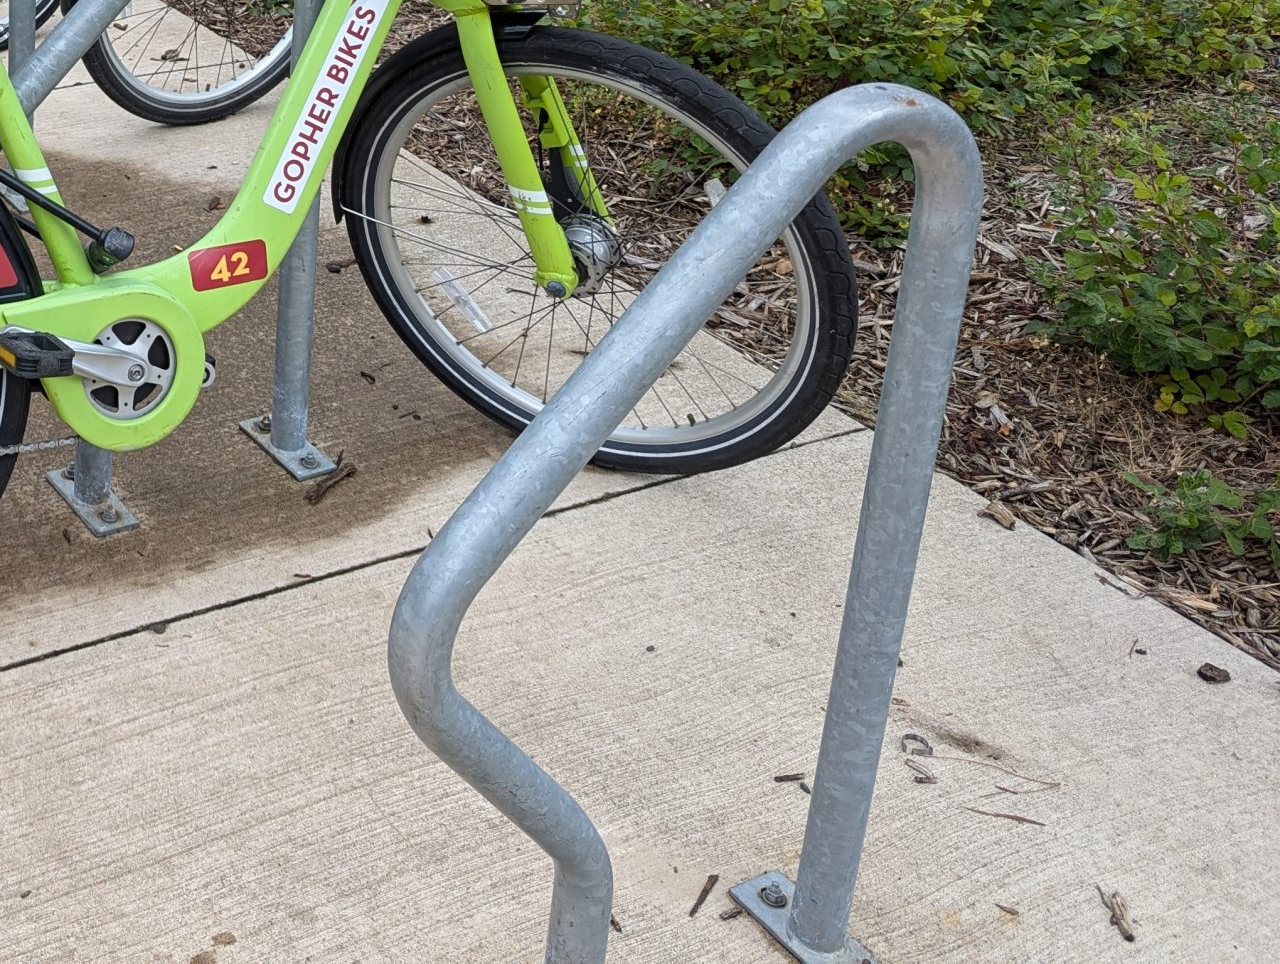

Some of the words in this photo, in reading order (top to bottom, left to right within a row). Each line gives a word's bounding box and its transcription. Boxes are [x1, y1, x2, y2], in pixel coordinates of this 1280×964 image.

[273, 86, 340, 203] GOPHER
[326, 5, 376, 85] BIKES
[210, 251, 251, 283] 42
